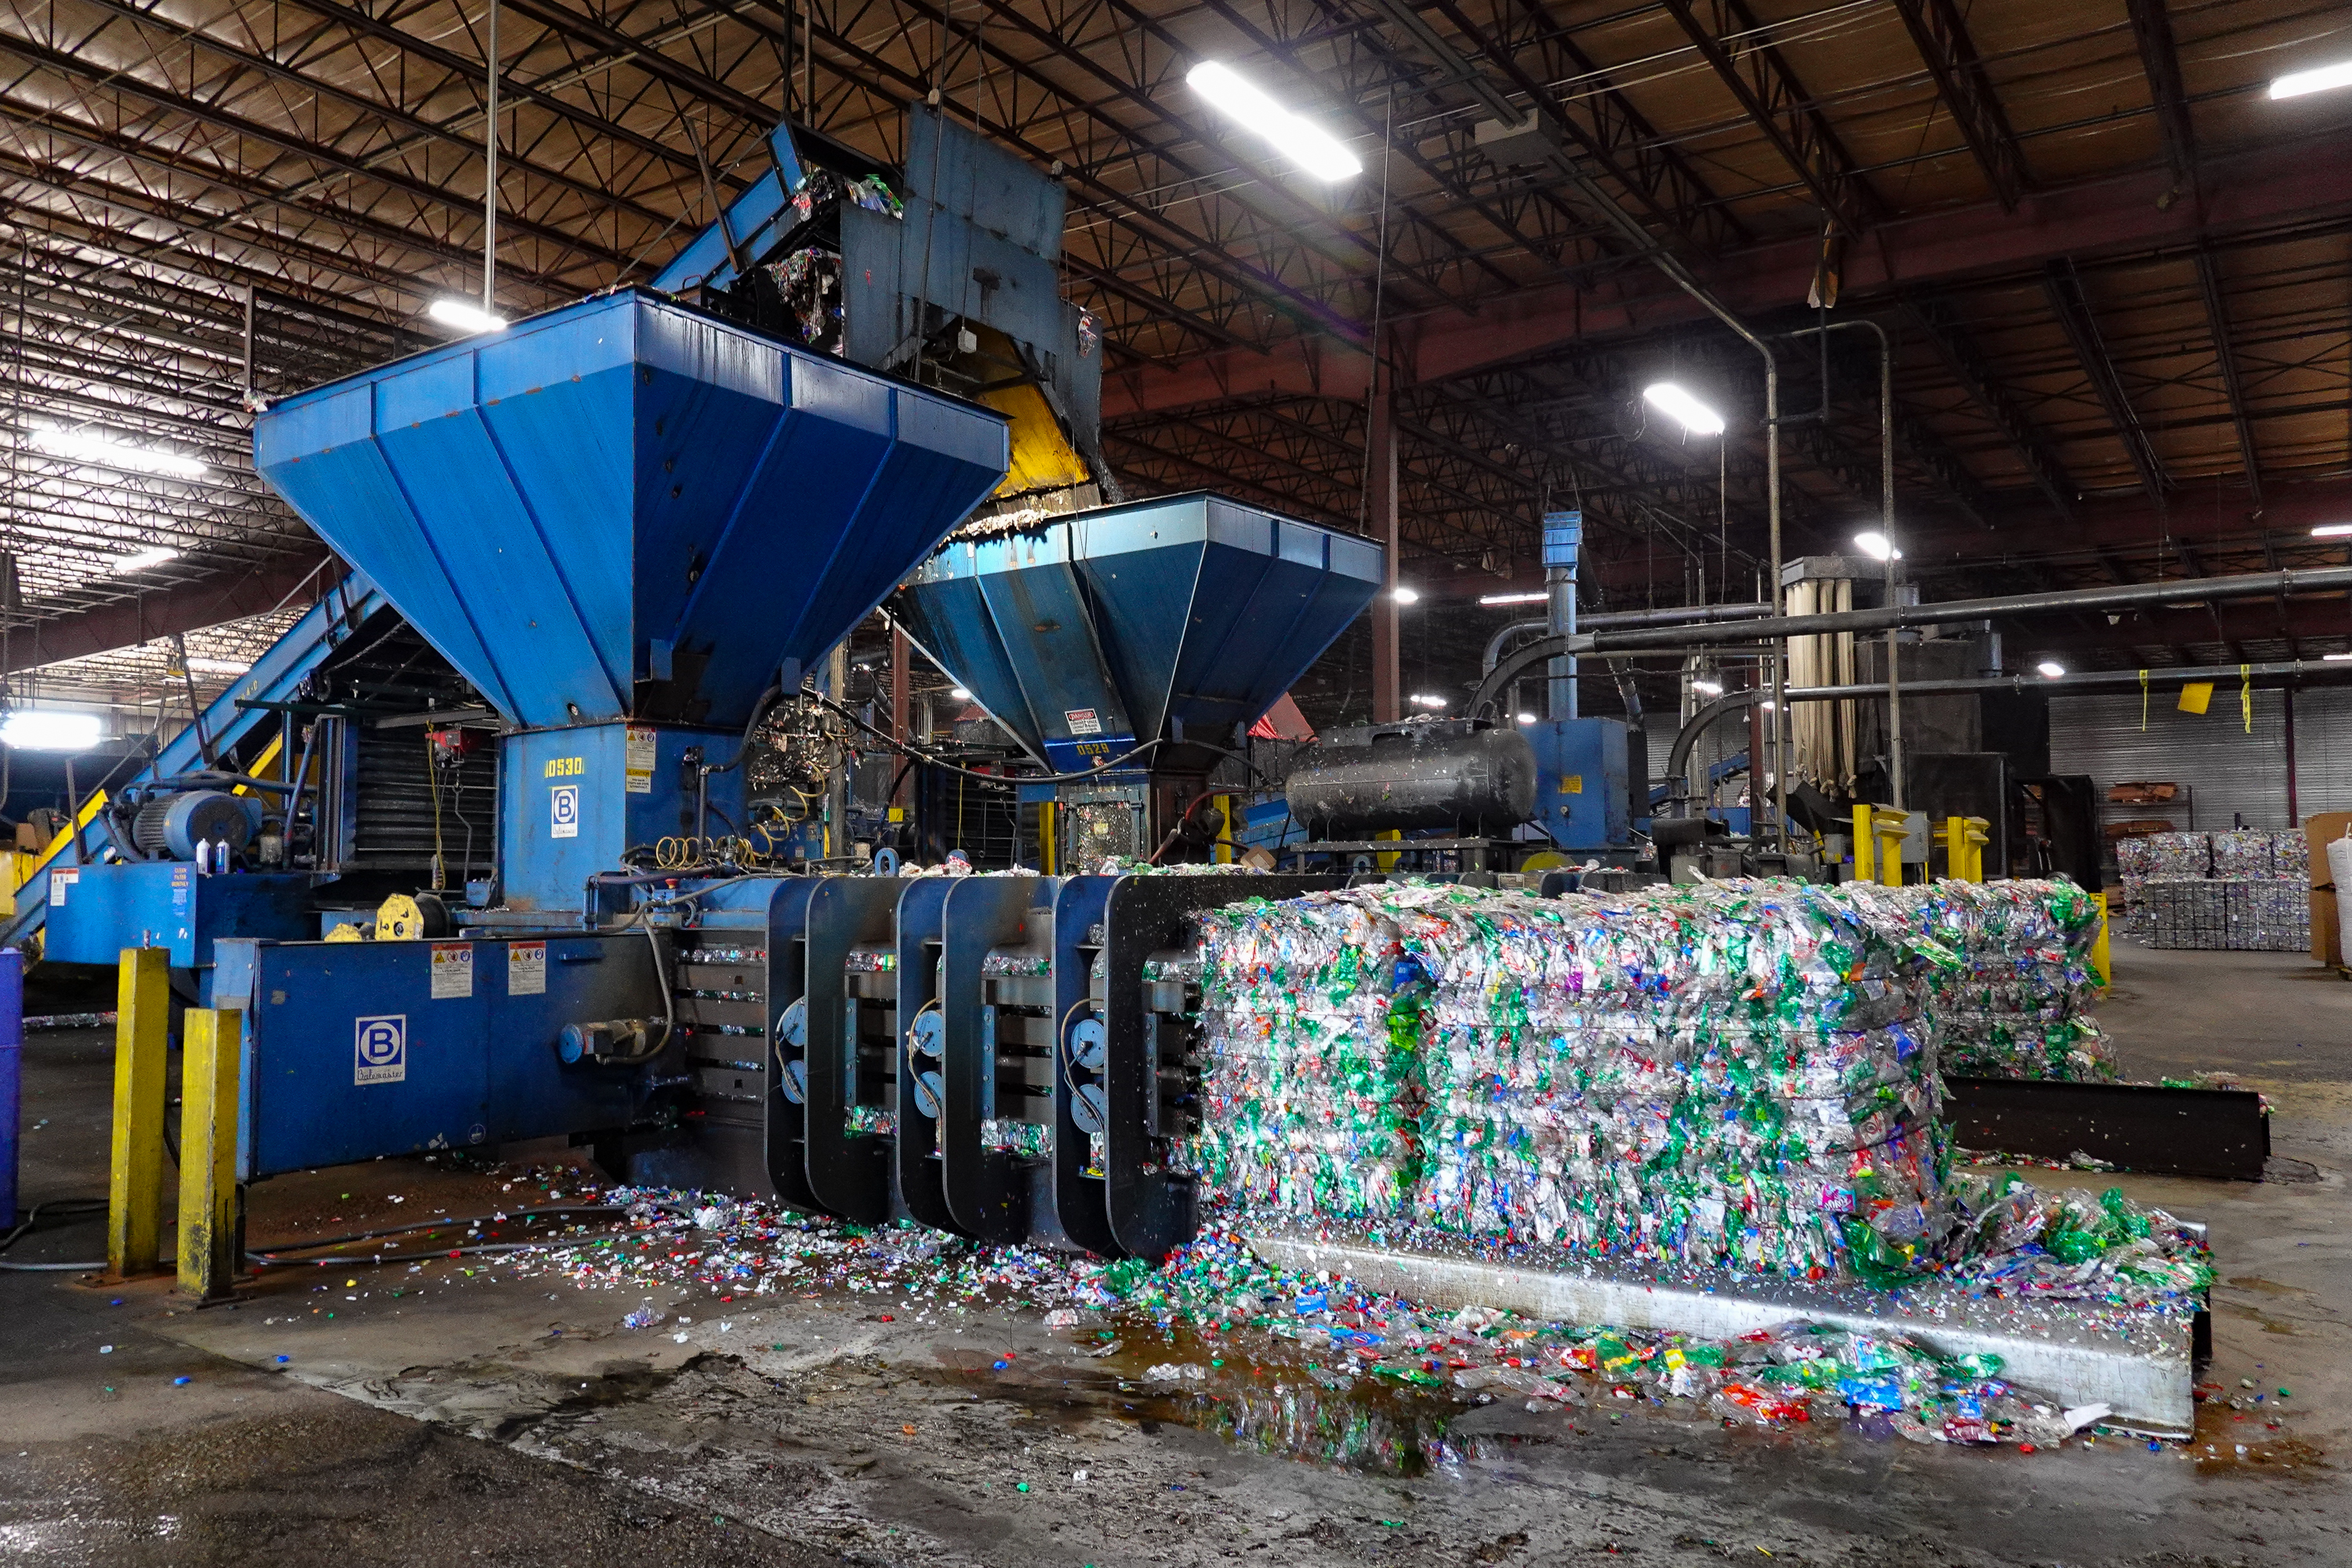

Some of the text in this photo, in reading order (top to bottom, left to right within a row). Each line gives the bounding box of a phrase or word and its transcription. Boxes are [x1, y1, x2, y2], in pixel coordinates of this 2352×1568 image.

[1071, 712, 1092, 720] DANGER
[1076, 742, 1110, 756] 0529
[558, 795, 572, 818] B
[368, 1028, 394, 1058] B
